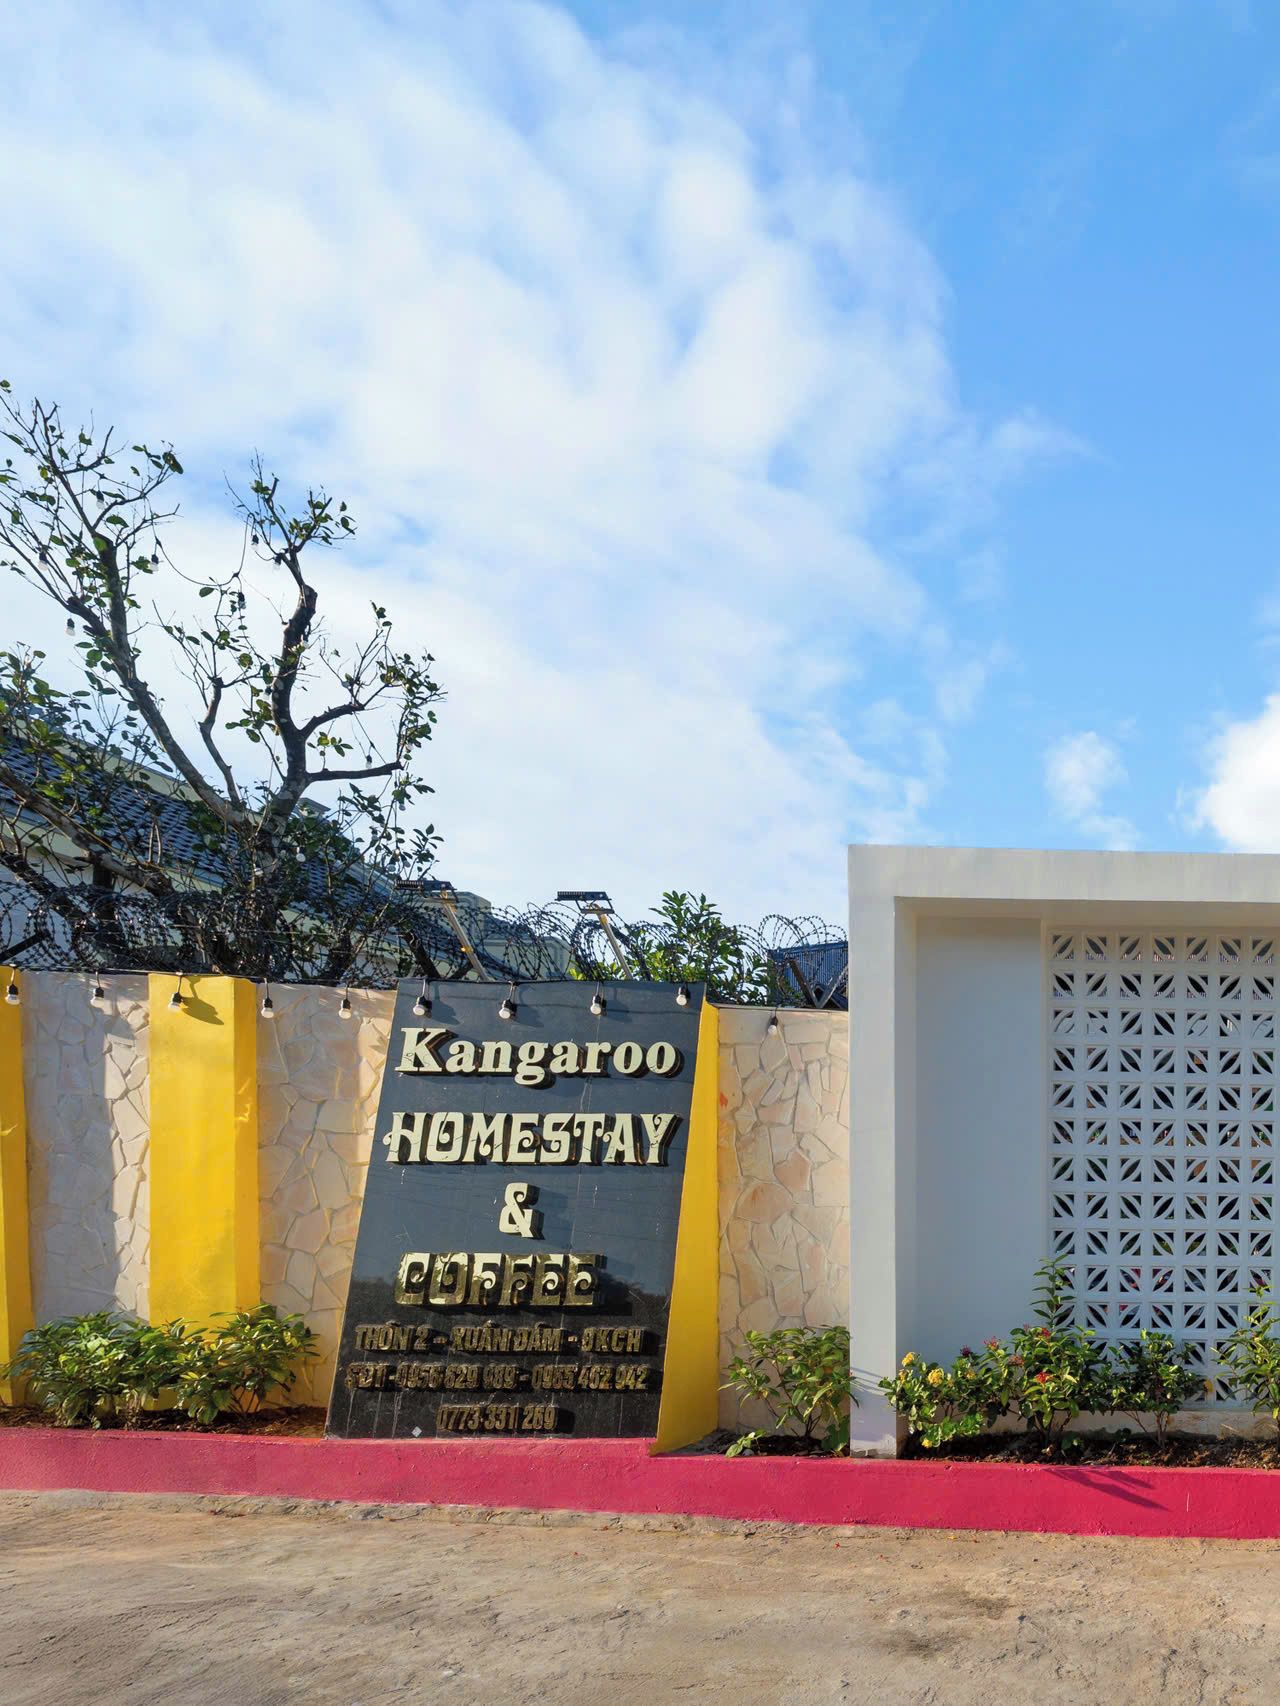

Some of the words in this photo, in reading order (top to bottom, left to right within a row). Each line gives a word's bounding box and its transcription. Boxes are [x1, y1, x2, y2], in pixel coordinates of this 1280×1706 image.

[395, 1028, 680, 1086] Kangaroo
[382, 1112, 678, 1165] HOMESTAY
[499, 1182, 539, 1238] &
[396, 1252, 604, 1307] COFFEE
[414, 1324, 433, 1350] 2
